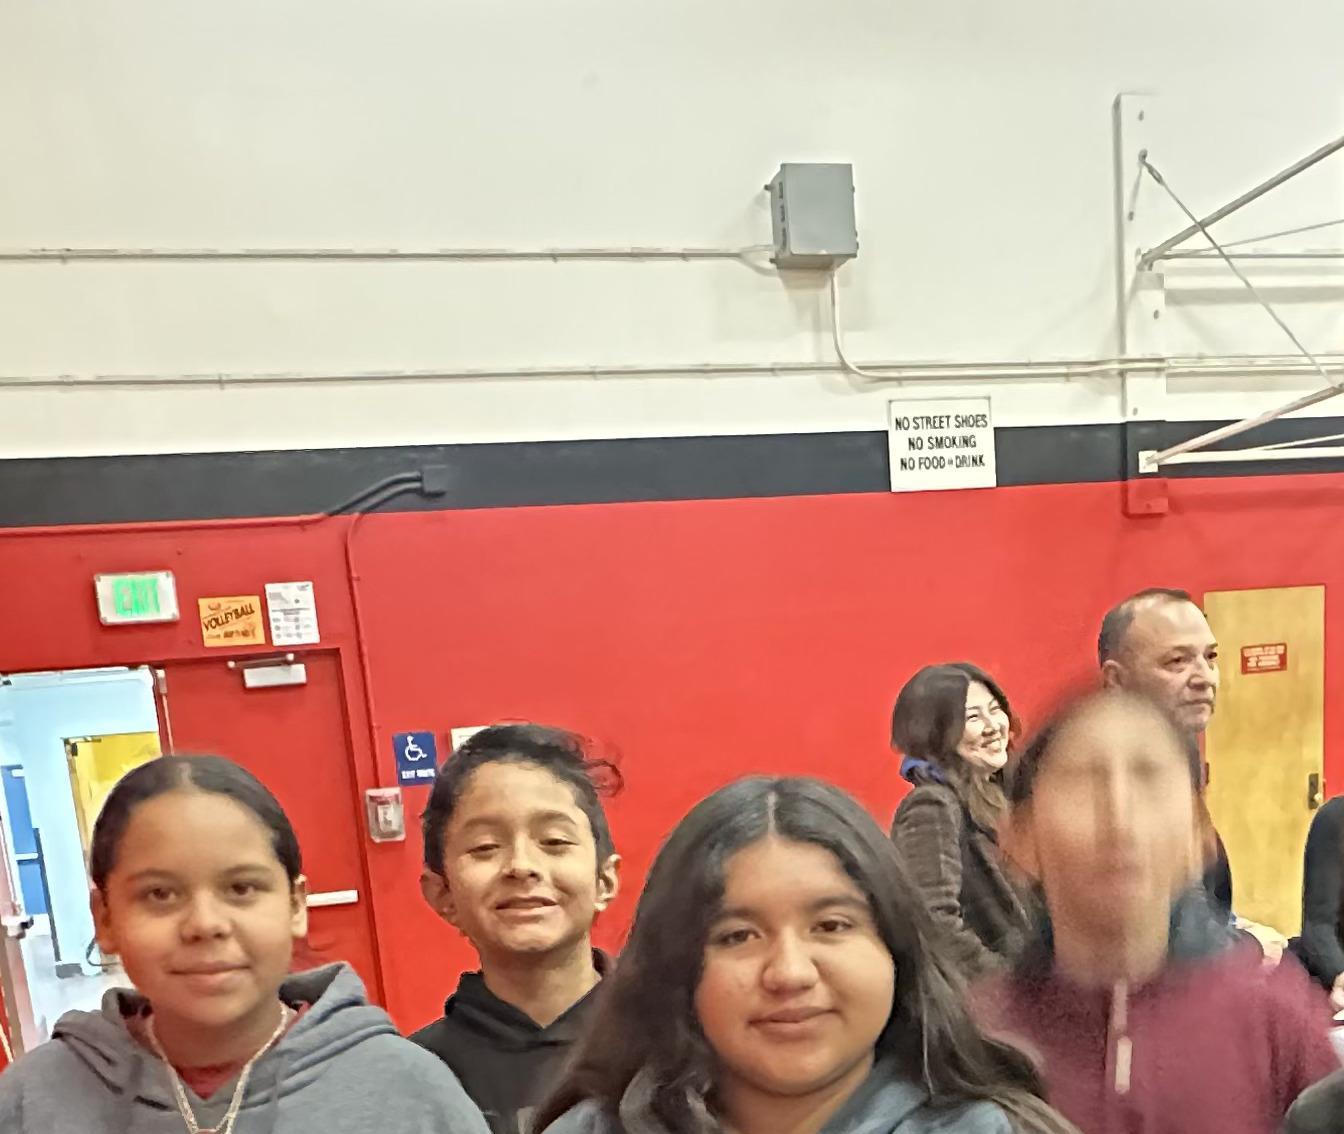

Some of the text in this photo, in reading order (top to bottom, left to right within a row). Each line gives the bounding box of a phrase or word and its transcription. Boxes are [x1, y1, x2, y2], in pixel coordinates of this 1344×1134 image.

[895, 414, 988, 431] NO STREET SHOES
[908, 435, 976, 451] NO SMOKING
[900, 457, 915, 471] NO
[918, 456, 946, 470] FOOD
[955, 454, 985, 468] DRINK
[203, 602, 256, 632] VOLLEYBALL
